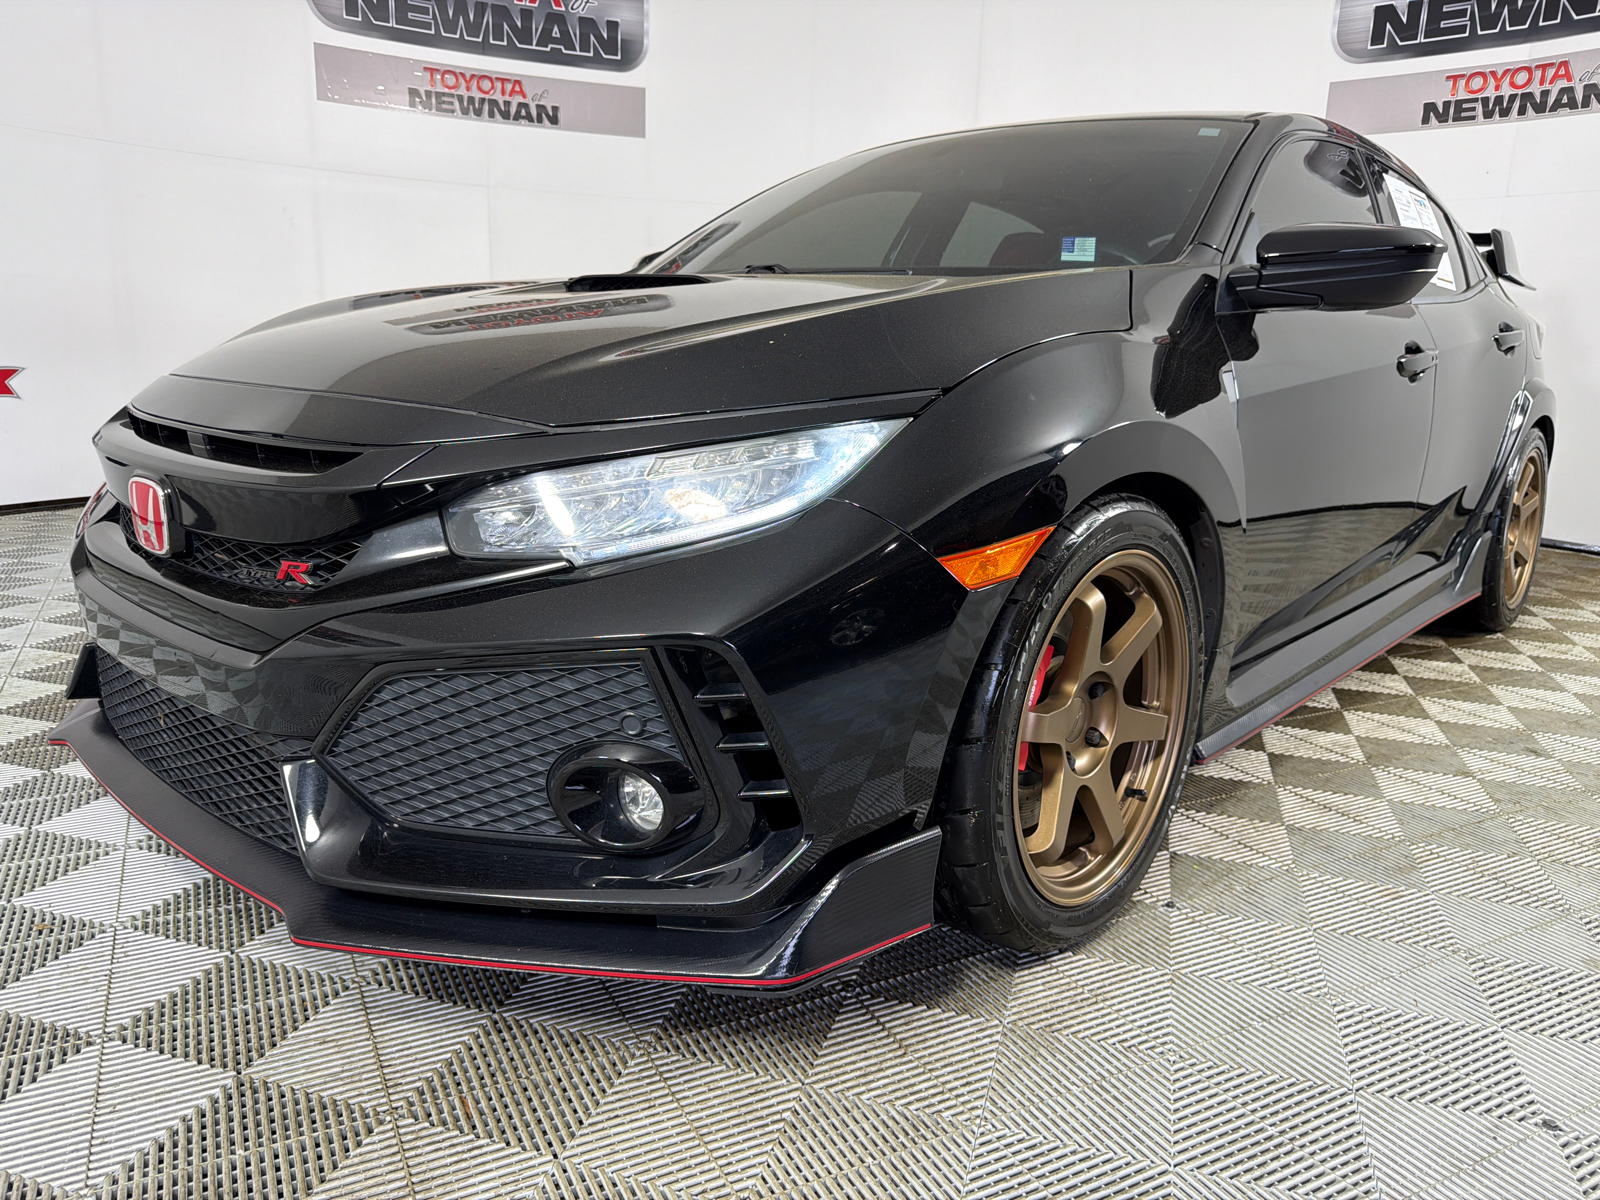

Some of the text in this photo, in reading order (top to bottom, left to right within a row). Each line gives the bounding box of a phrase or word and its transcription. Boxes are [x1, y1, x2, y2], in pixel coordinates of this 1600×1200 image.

[342, 0, 622, 60] NEWNAN
[423, 66, 528, 100] TOYOTA
[1445, 59, 1574, 97] TOYOTA
[407, 86, 561, 126] NEWNAN
[1420, 82, 1600, 127] NEWNAN
[277, 560, 313, 584] R
